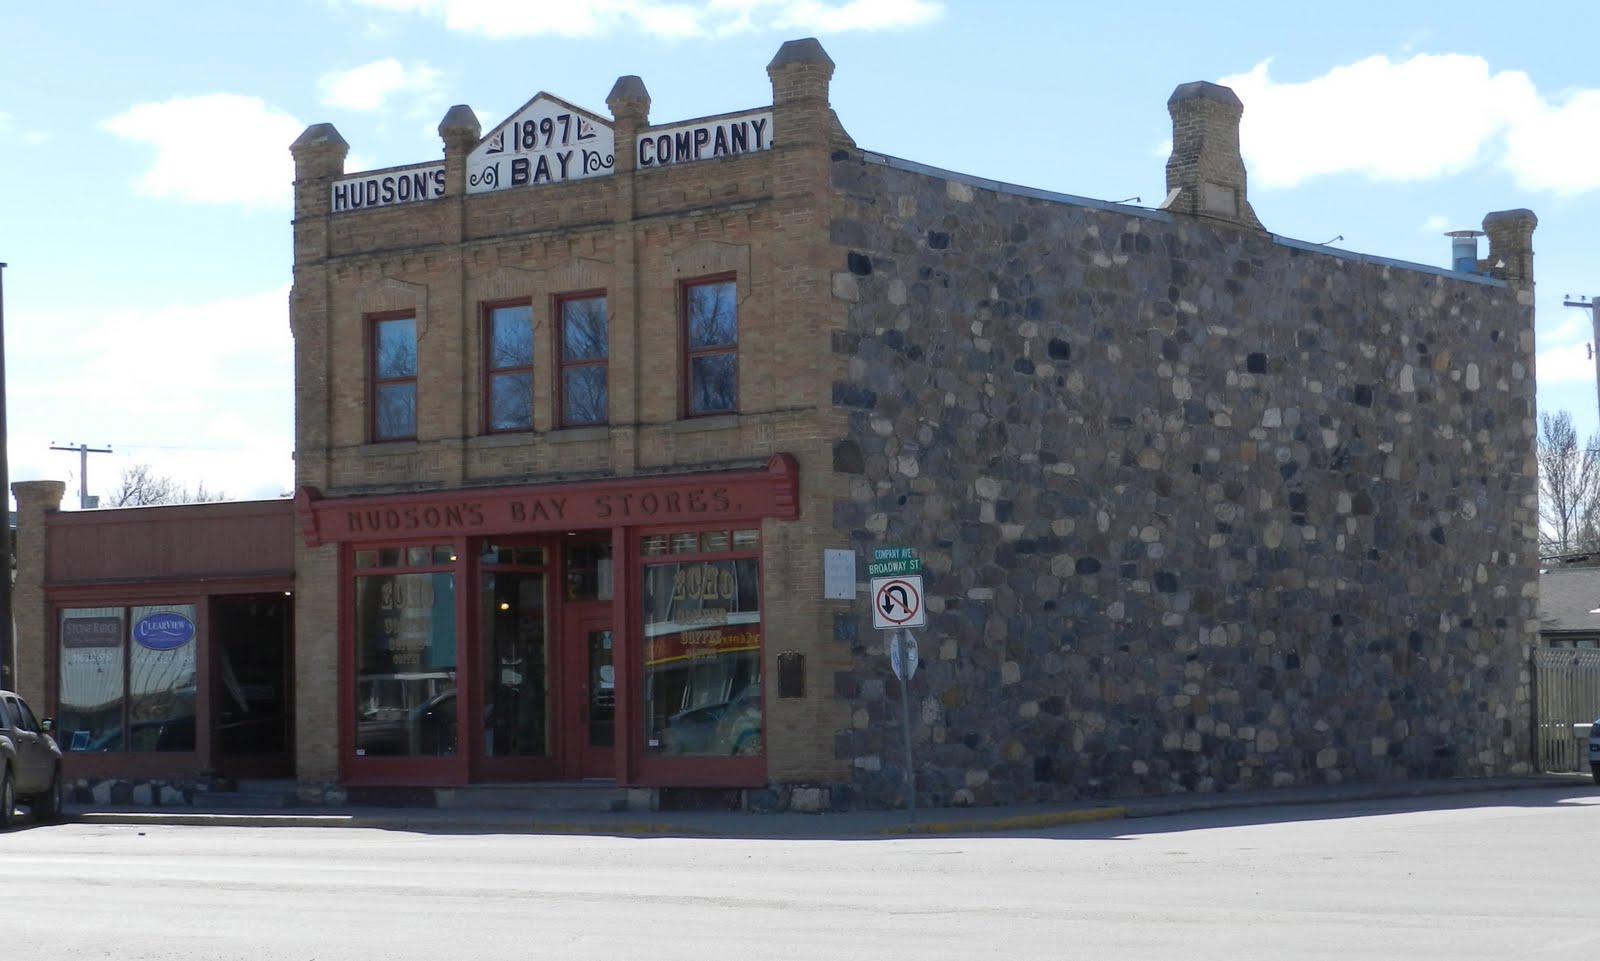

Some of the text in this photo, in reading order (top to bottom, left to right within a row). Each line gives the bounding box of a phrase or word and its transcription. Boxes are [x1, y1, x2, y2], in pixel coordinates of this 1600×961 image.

[513, 114, 572, 152] 1897
[511, 150, 573, 186] BAY
[334, 169, 445, 211] HUDSON'S
[346, 502, 485, 532] HUDSON'S
[510, 497, 568, 523] BAY
[869, 559, 919, 575] BROADWAY ST
[874, 548, 912, 560] COMPANY AVE
